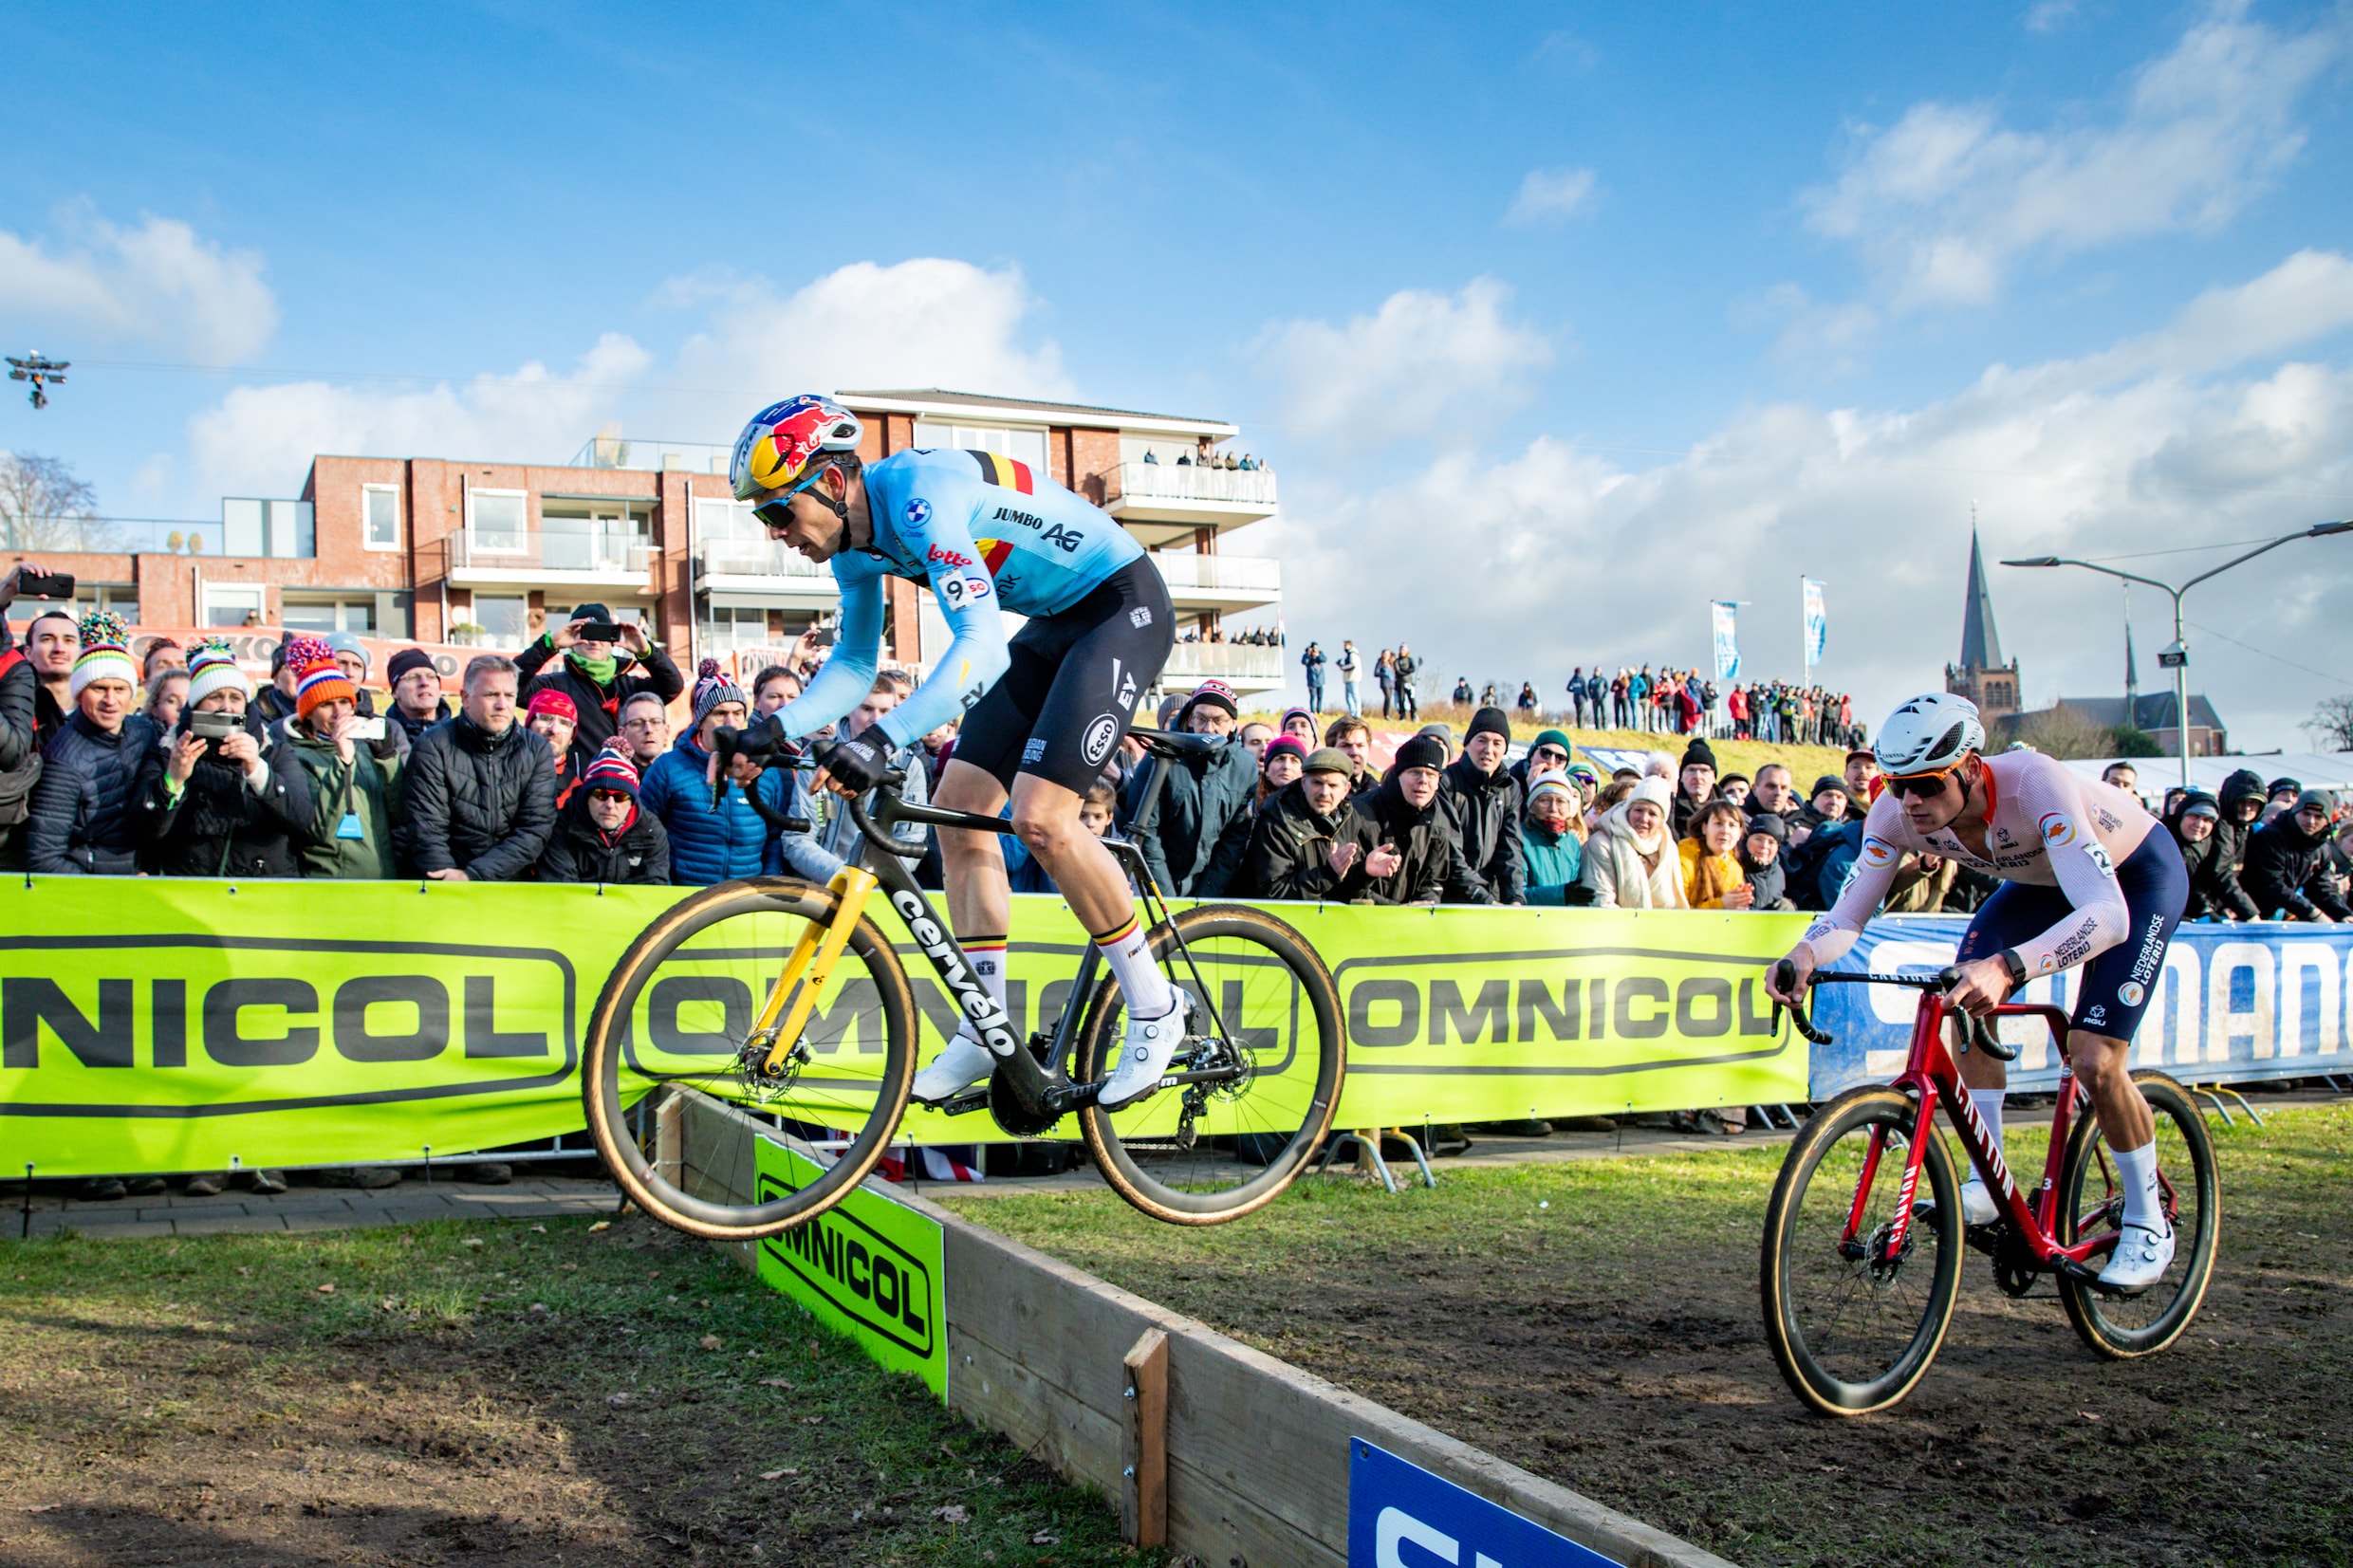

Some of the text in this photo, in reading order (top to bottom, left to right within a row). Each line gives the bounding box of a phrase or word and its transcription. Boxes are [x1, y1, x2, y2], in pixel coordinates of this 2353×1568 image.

[991, 507, 1044, 530] JUMBO
[926, 543, 973, 567] lotto
[946, 580, 964, 602] 9
[960, 681, 985, 710] EY
[1117, 671, 1138, 711] EY
[1999, 840, 2020, 851] AGU
[2052, 915, 2099, 959] NEDERLANDSE
[2129, 913, 2165, 981] NEDERLANDSE
[2057, 940, 2091, 969] LOTERIJ
[2140, 938, 2165, 986] LOTERIJ
[1868, 972, 1933, 983] CANYON
[2, 974, 549, 1068] NICOL
[1347, 976, 1773, 1047] OMNICOL
[2083, 1017, 2107, 1027] AGU
[1955, 1072, 2015, 1201] CANYON
[2042, 1177, 2053, 1191] 3
[1888, 1165, 1918, 1244] CANYON
